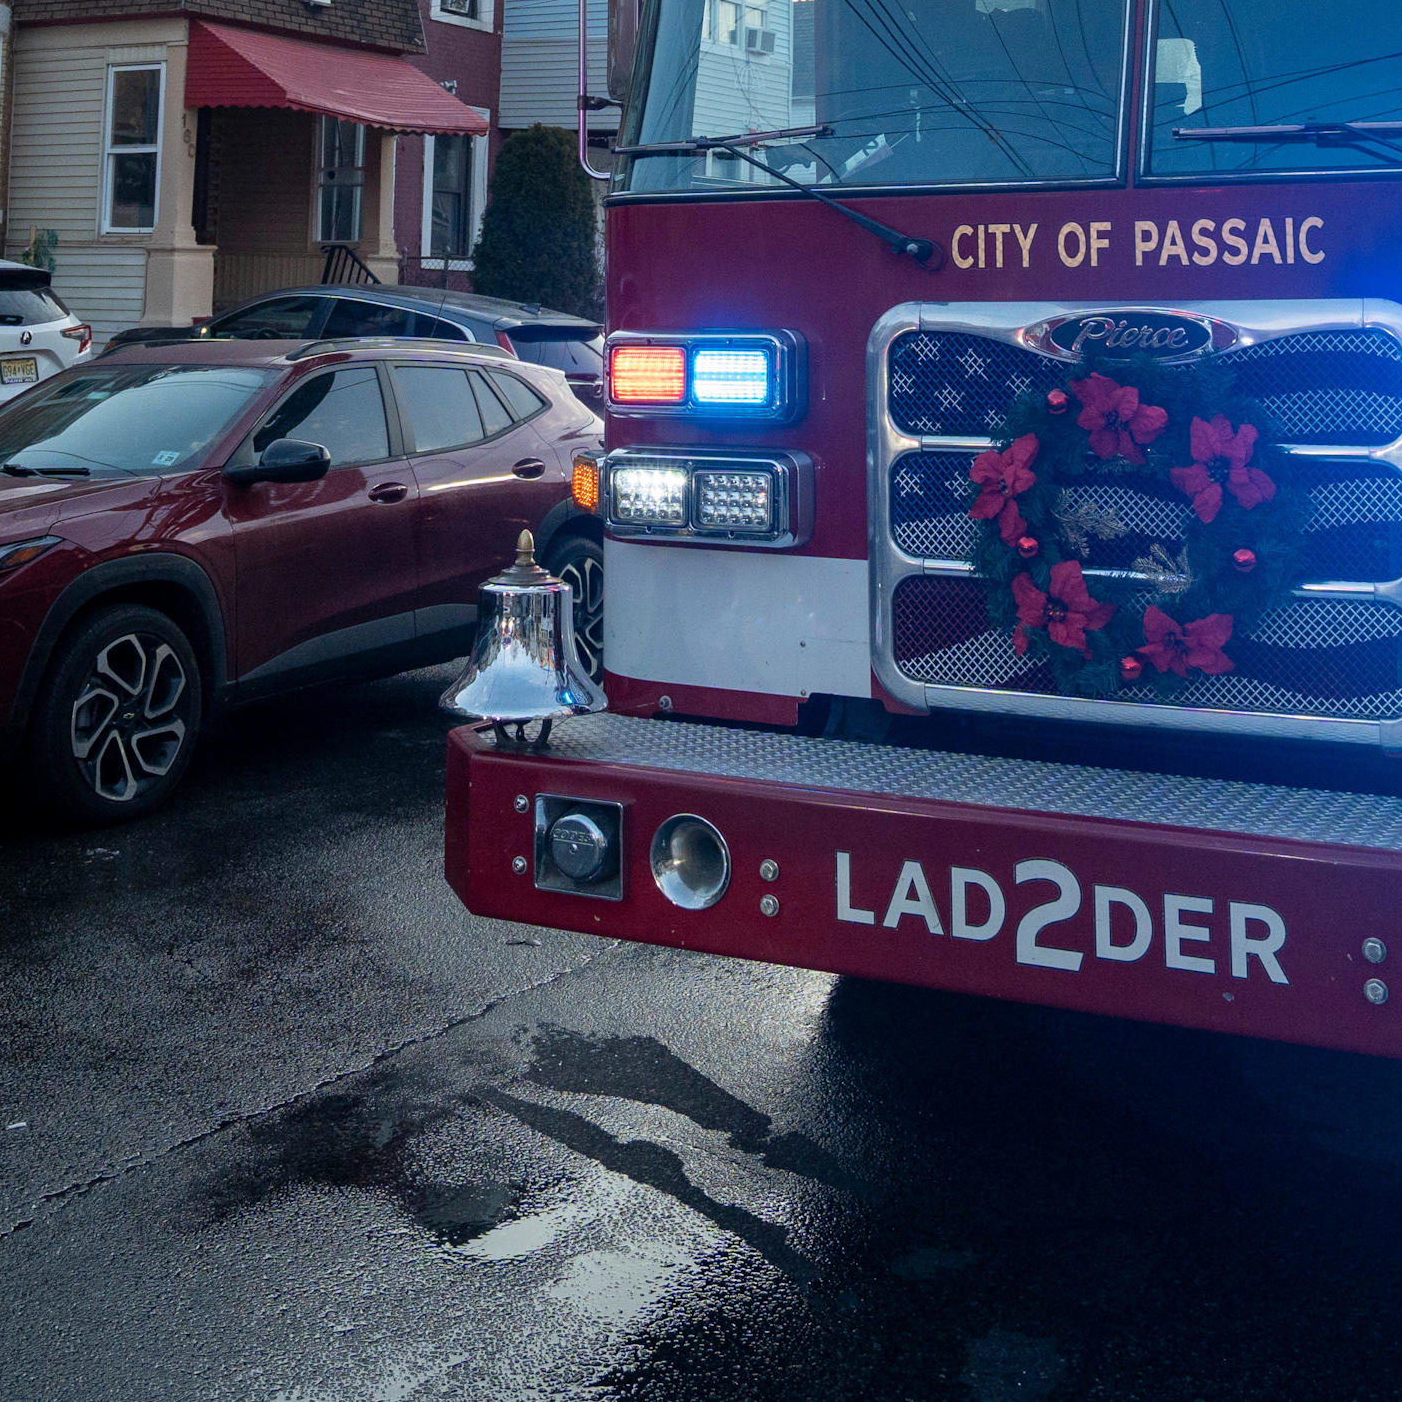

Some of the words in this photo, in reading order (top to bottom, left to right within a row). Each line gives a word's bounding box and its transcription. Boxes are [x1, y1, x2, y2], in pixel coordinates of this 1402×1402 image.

[951, 223, 1038, 269] CITY
[1057, 222, 1112, 267] OF
[1134, 216, 1326, 266] PASSAIC
[1071, 317, 1188, 353] Pierce
